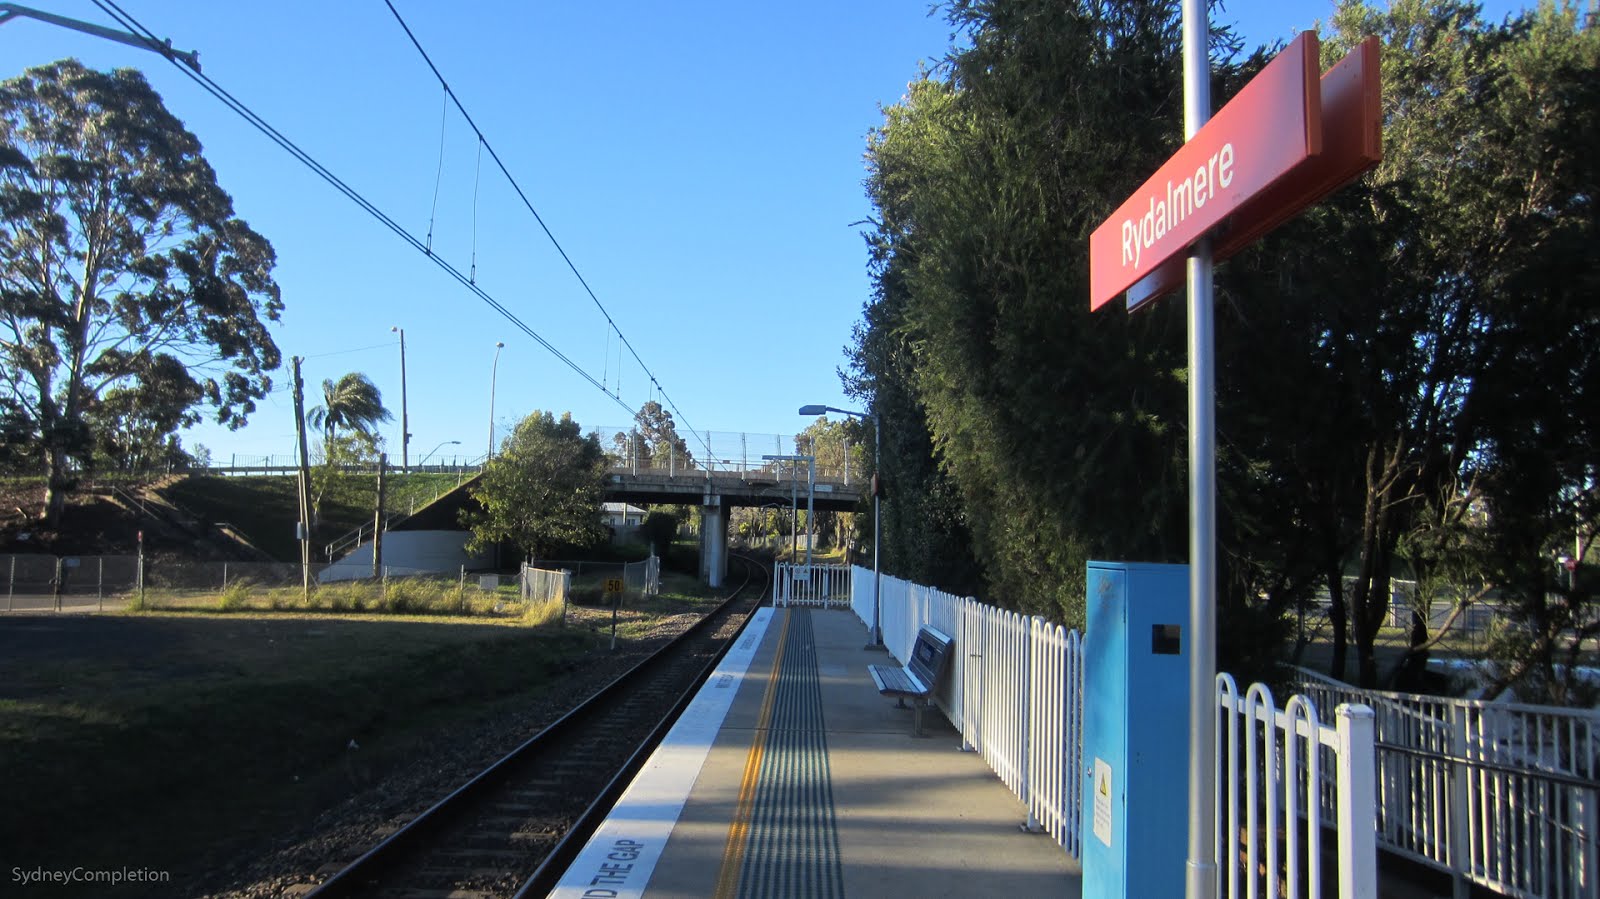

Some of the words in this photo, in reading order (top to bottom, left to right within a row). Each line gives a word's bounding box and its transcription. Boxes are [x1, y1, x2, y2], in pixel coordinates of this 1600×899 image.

[1122, 143, 1233, 270] Rydalmere
[608, 580, 620, 591] 50
[607, 840, 644, 861] GAP
[590, 863, 634, 886] THE
